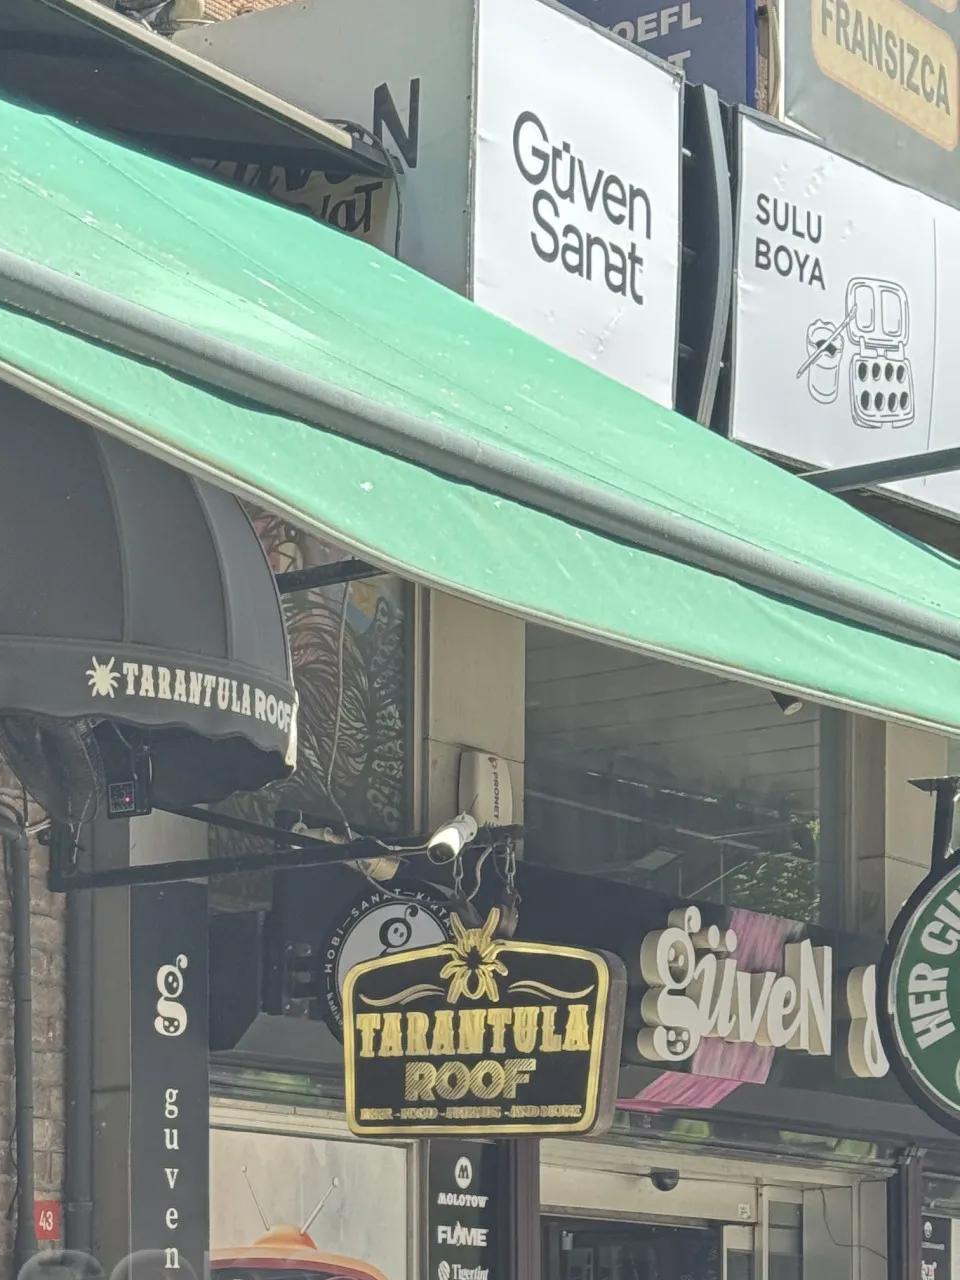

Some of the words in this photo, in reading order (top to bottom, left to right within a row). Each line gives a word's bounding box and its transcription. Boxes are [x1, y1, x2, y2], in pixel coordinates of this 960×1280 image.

[604, 3, 702, 42] OEFL
[821, 0, 951, 116] FRANSIZCA
[512, 110, 652, 240] Güven
[755, 192, 823, 245] SULU
[530, 189, 645, 306] Sanat
[754, 237, 826, 291] BOYA
[122, 662, 252, 717] TARANTULA
[355, 1003, 591, 1057] TARANTULA
[908, 962, 957, 1050] HER
[404, 1058, 537, 1102] ROOF
[39, 1210, 54, 1231] 43
[437, 1192, 489, 1208] MOLOTOW
